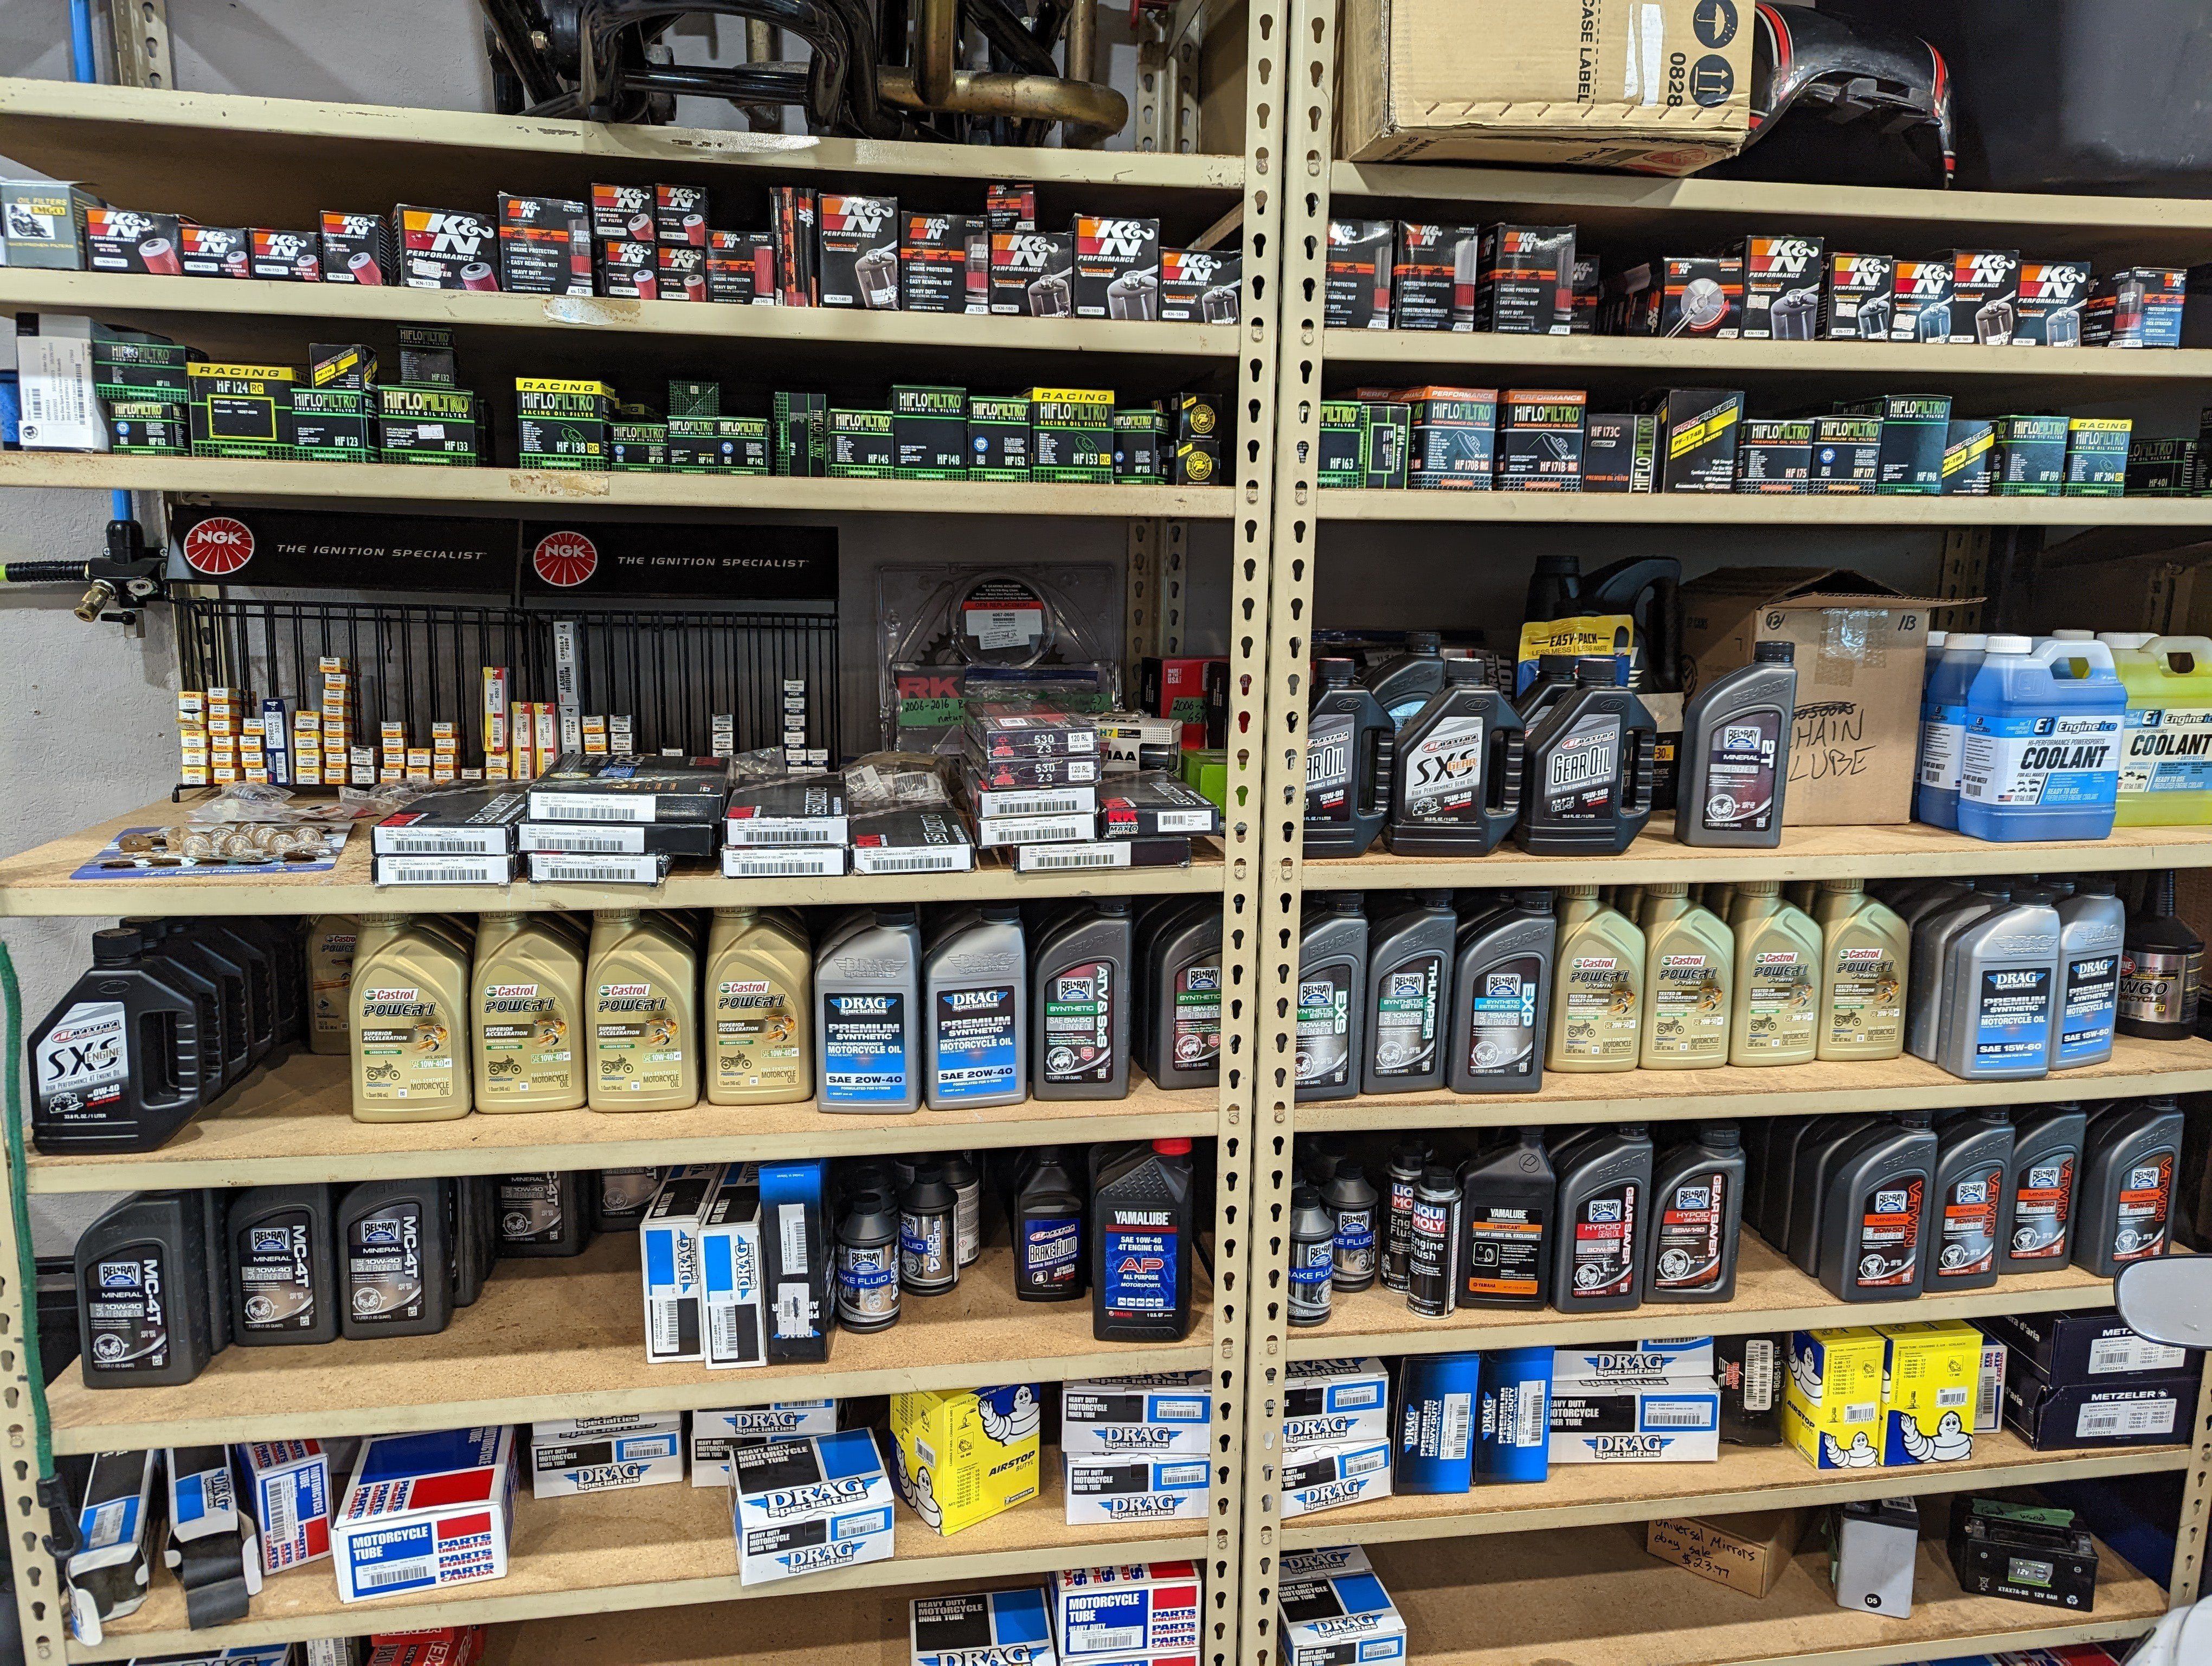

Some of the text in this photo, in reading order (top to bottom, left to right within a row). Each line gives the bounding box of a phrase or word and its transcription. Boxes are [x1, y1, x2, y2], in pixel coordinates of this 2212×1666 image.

[1577, 0, 1595, 104] CASE LABEL
[1667, 52, 1687, 107] 0828
[406, 250, 475, 261] PERFORMANCE
[1078, 255, 1135, 263] PERFORMANCE
[199, 366, 280, 377] RACING
[217, 381, 263, 394] HF 124 RC
[523, 382, 595, 392] RACING
[294, 393, 359, 408] HIFLOFILTRO
[383, 392, 469, 413] HIFLOFILTRO
[522, 392, 595, 411] HIFLOFILTRO
[1041, 392, 1108, 401] RACING
[835, 413, 890, 427] HIFLOFILTRO
[613, 426, 664, 439] HIFLOFILTRO
[1591, 426, 1621, 438] HF 173C
[445, 441, 468, 451] HF 133
[556, 441, 599, 453] HF 138 RC
[937, 454, 960, 465] HF 148
[1073, 453, 1110, 465] HF 153 RC
[1330, 458, 1353, 469] HF 163
[1540, 461, 1566, 472] HF 171B
[1854, 468, 1875, 478] HF 177
[1917, 471, 1937, 482] HF 198
[2094, 472, 2114, 482] HF 204
[197, 530, 242, 544] NGK
[278, 544, 483, 560] THE IGNITION SPECIALIST
[545, 544, 586, 557] NGK
[618, 555, 806, 569] THE IGNITION SPECIALIST
[1549, 632, 1598, 646] EASY-PACK
[1550, 647, 1571, 655] MESS
[898, 676, 959, 699] RK
[1100, 729, 1113, 737] H7
[1789, 709, 1864, 750] HAIN
[1034, 734, 1053, 744] 530
[2130, 734, 2212, 756] COOLANT
[1322, 745, 1347, 777] OIL
[1788, 745, 1876, 782] LUBE
[2020, 746, 2110, 770] COOLANT
[1552, 745, 1611, 785] GEAR OIL
[1320, 790, 1344, 800] 75W-90
[1443, 792, 1472, 802] 75W-140
[1109, 811, 1137, 823] RK
[611, 985, 647, 995] Castrol
[731, 983, 767, 993] Castrol
[1097, 966, 1108, 1001] ATV
[377, 989, 415, 1000] Castrol
[498, 986, 535, 996] Castrol
[953, 991, 998, 1004] DRAG
[840, 998, 886, 1008] DRAG
[1426, 959, 1438, 1040] THUMPER
[1522, 983, 1535, 1027] EXP
[1984, 996, 2046, 1007] PREMIUM
[1097, 1002, 1108, 1014] &
[1335, 990, 1347, 1034] EXS
[828, 1023, 900, 1033] PREMIUM
[1981, 1017, 2031, 1026] MOTORCYCLE
[2082, 1028, 2110, 1040] 15W-60
[828, 1045, 902, 1054] MOTORCYCLE OIL
[1979, 1043, 2042, 1053] SAE 15W-60
[93, 1085, 119, 1097] 0W-40
[410, 1081, 449, 1091] MOTORCYCLE
[1114, 1210, 1169, 1226] YAMALUBE
[1904, 1181, 1922, 1248] V-TWIN
[1029, 1237, 1078, 1263] BRAKE FLUID
[1412, 1235, 1444, 1252] Engine
[678, 1238, 690, 1285] DRAG
[1117, 1258, 1164, 1272] AP
[861, 1275, 888, 1285] FLUID
[143, 1259, 162, 1325] MC-4T
[2091, 1391, 2156, 1400] METZELER
[1069, 1403, 1108, 1412] MOTORCYCLE
[1105, 1427, 1169, 1443] DRAG
[738, 1446, 808, 1463] MOTORCYCLE
[988, 1450, 1036, 1477] AIRSTOP
[1016, 1460, 1033, 1472] BUTYL
[577, 1463, 640, 1482] DRAG
[764, 1477, 867, 1511] DRAG
[352, 1526, 429, 1548] MOTORCYCLE
[1655, 1532, 1713, 1559] ebay sale
[1710, 1537, 1755, 1561] Mirrors
[353, 1546, 383, 1561] TUBE
[441, 1568, 494, 1582] CANADA
[1069, 1593, 1140, 1610] MOTORCYCLE
[1866, 1597, 1878, 1605] D5
[1069, 1610, 1096, 1623] TUBE
